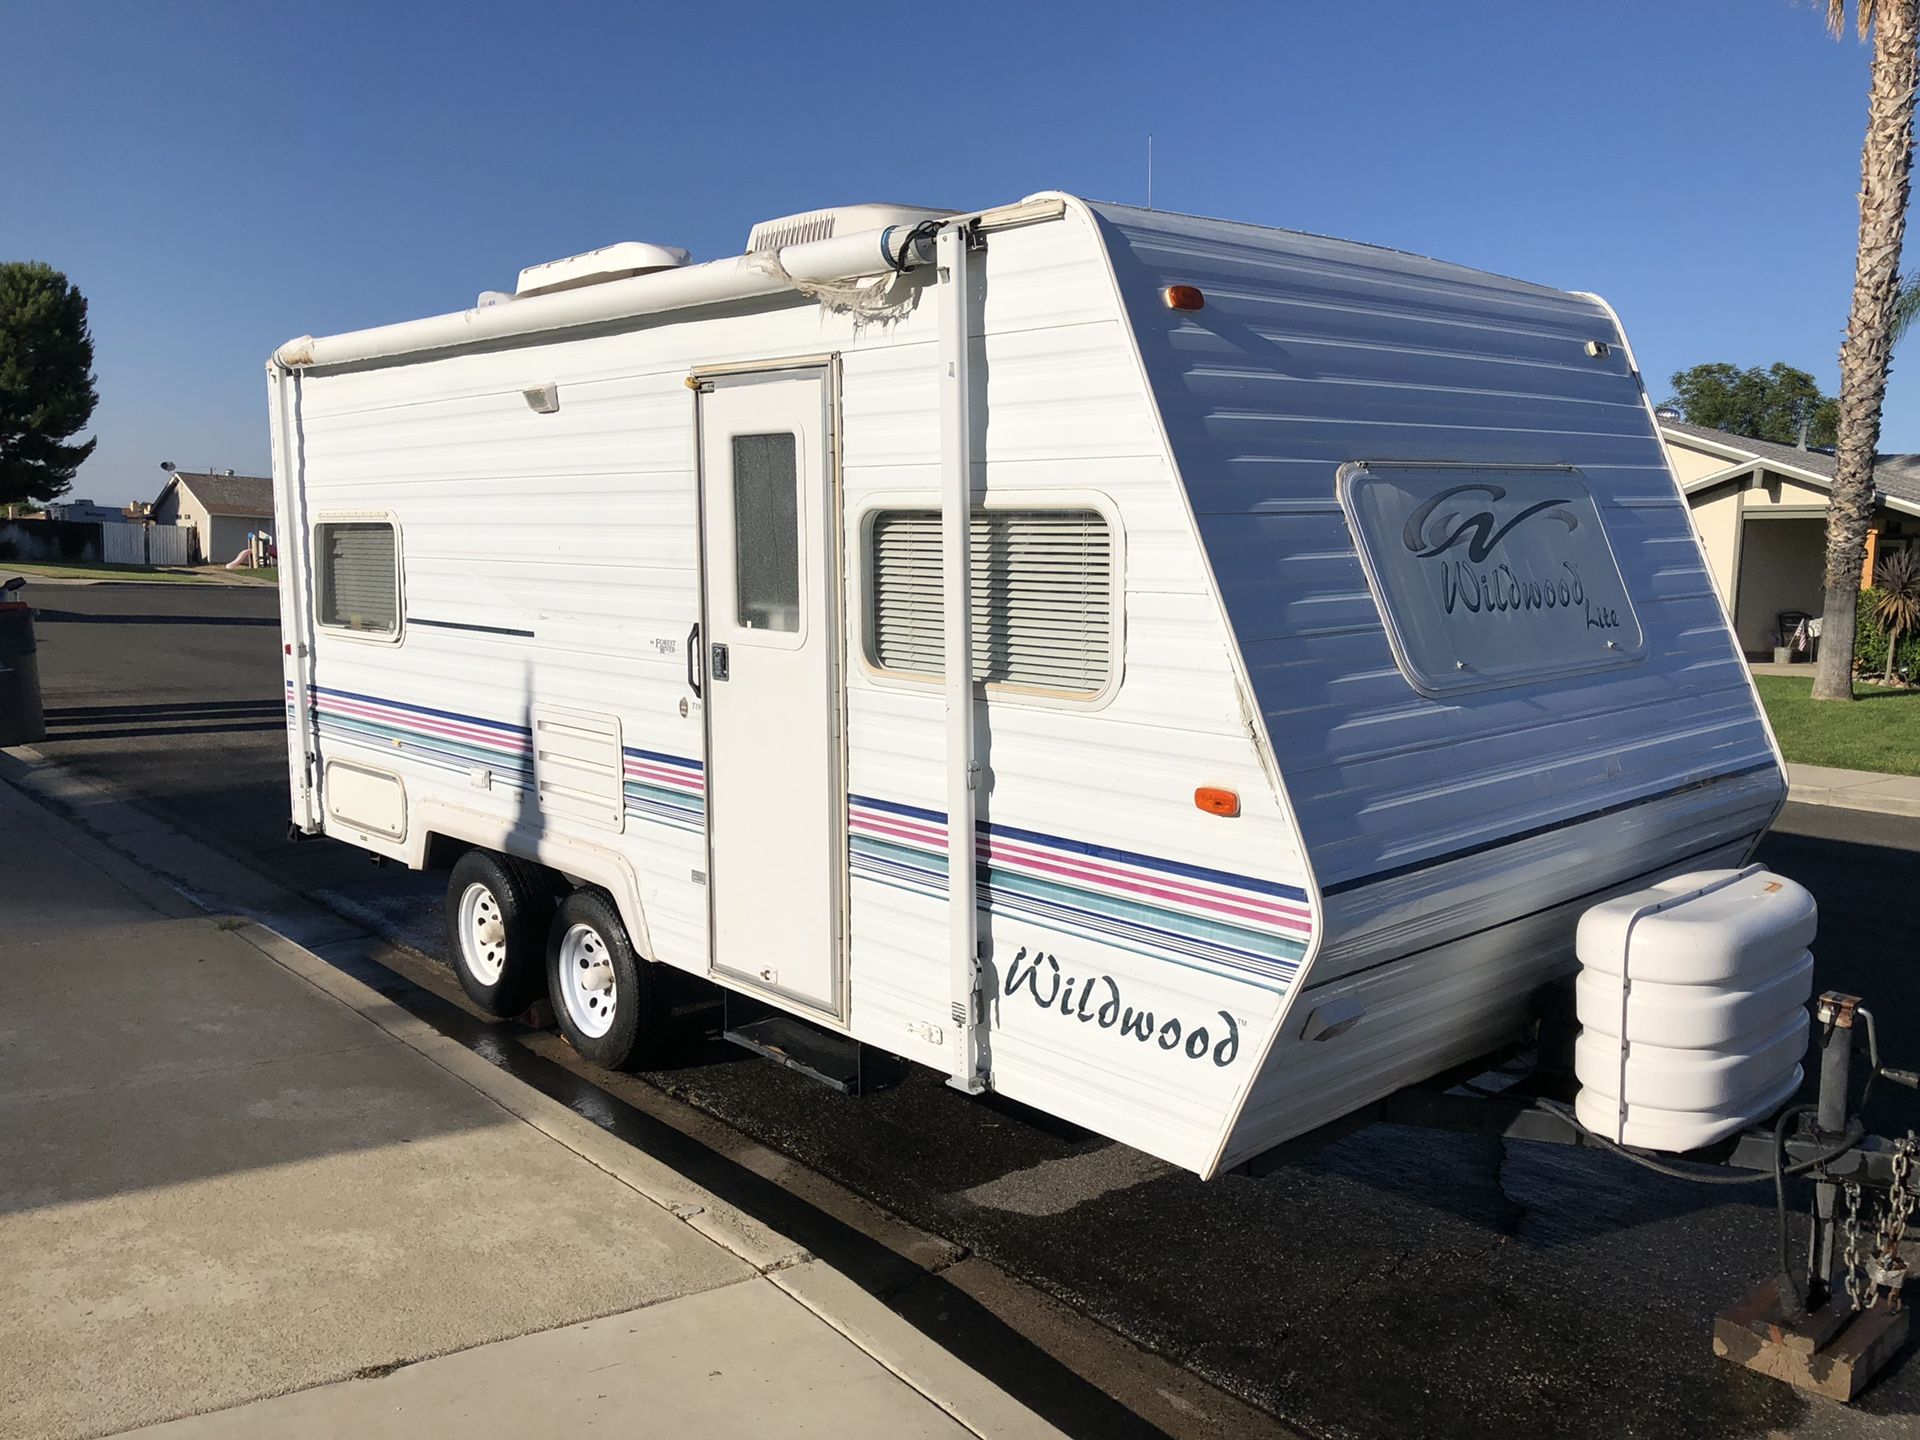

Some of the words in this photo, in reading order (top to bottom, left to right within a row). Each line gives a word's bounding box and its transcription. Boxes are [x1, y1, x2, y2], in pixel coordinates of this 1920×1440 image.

[1441, 560, 1584, 615] Wildwood
[1585, 598, 1620, 631] Lite
[655, 638, 676, 648] FOREST
[659, 645, 675, 655] RIVER
[1004, 946, 1239, 1067] Wildwood
